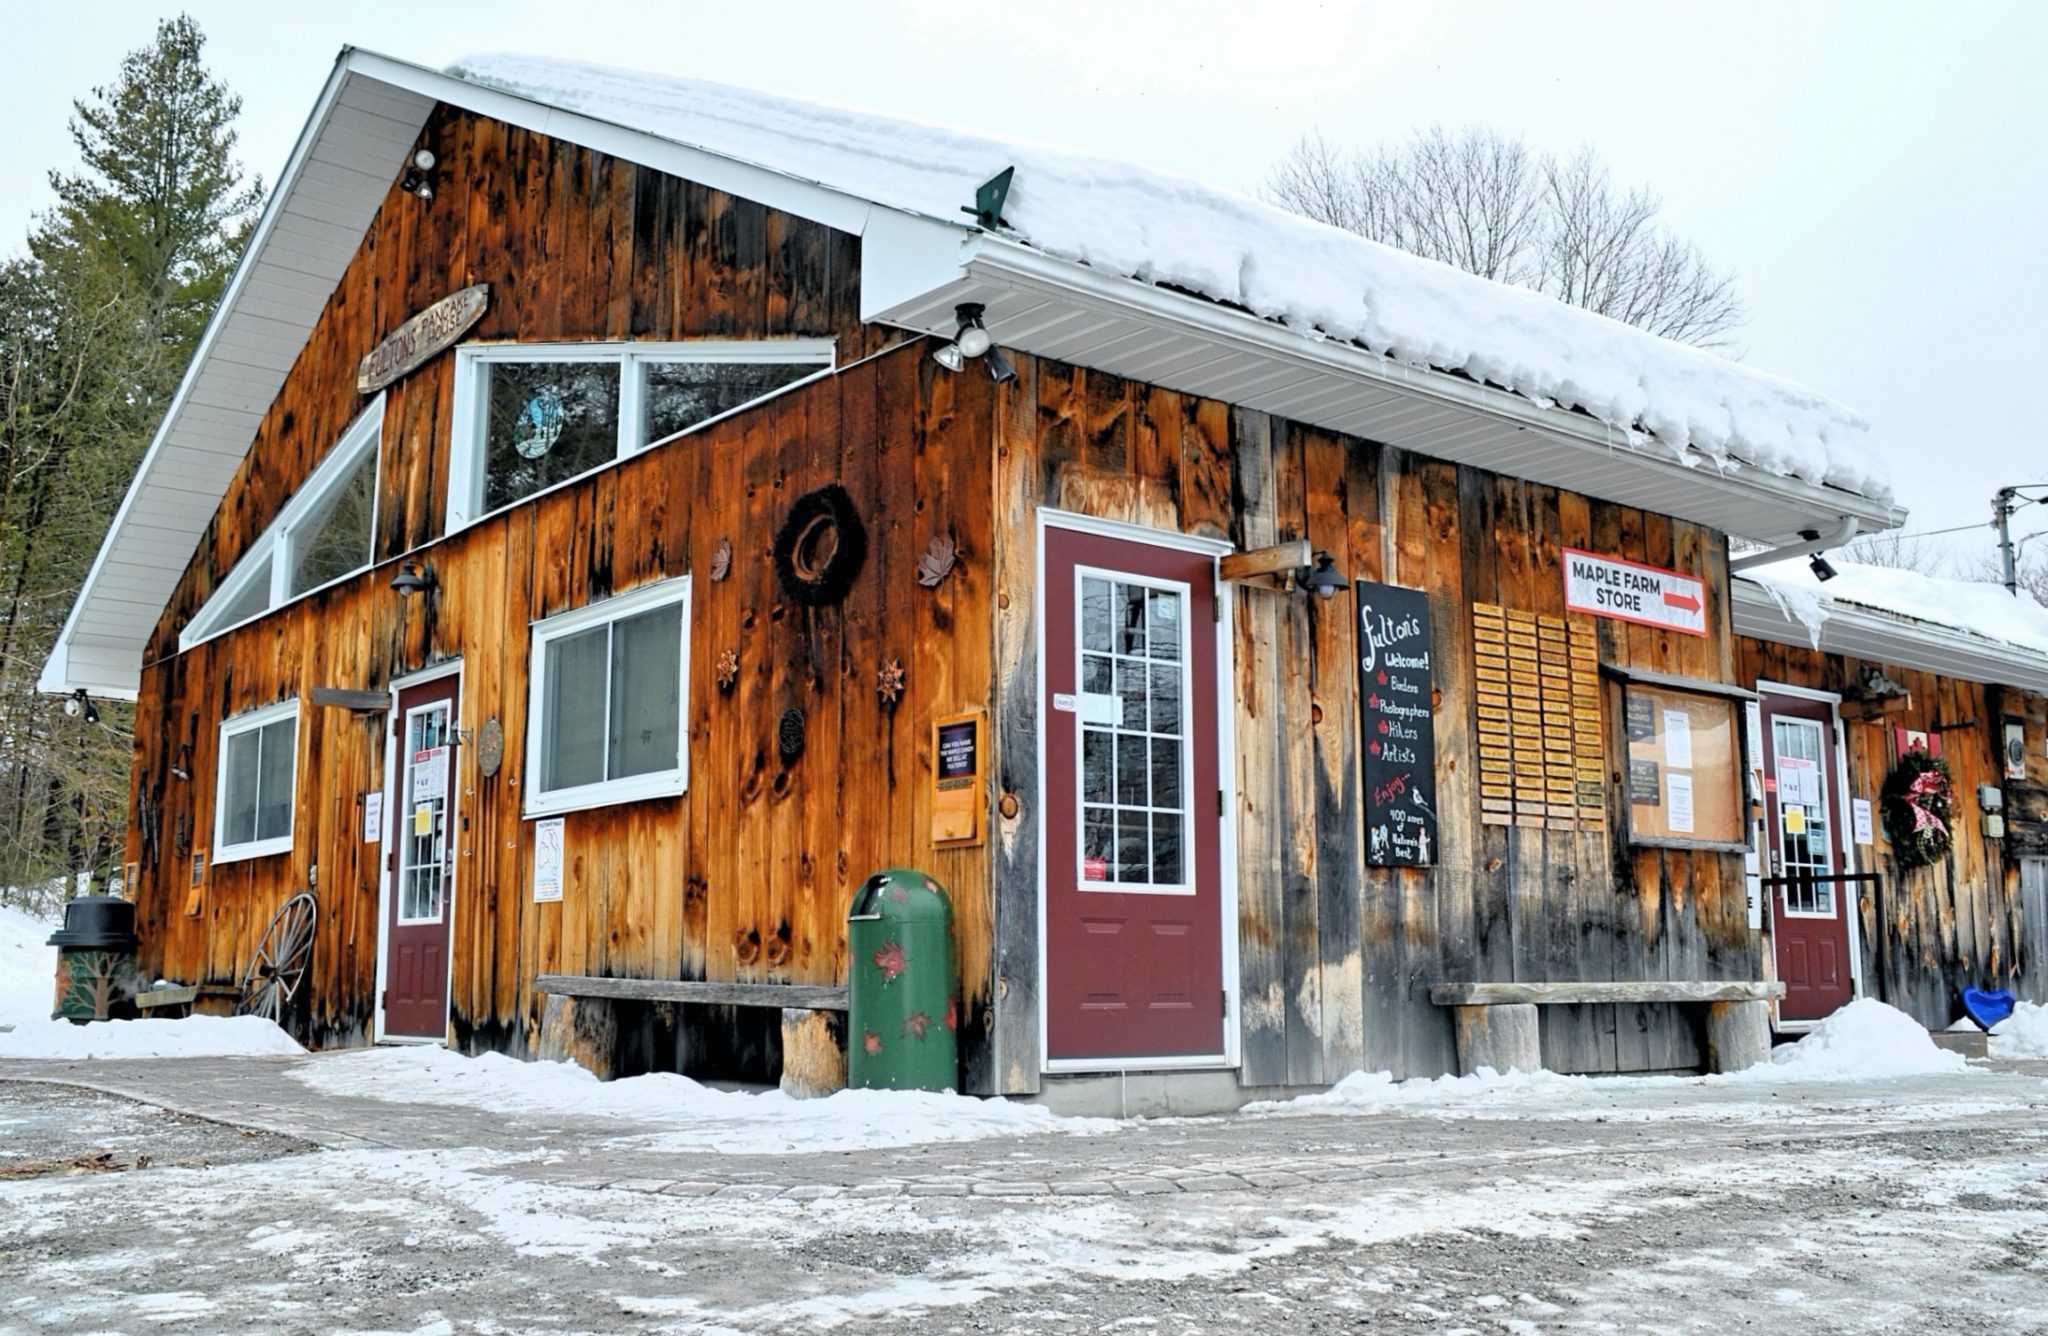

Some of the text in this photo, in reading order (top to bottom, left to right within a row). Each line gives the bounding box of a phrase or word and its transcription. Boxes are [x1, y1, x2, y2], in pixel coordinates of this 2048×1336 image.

[421, 291, 469, 336] PANCAKE
[428, 312, 461, 343] HOUSE
[1572, 561, 1661, 596] MAPLE FARM
[1596, 588, 1642, 612] STORE
[1379, 699, 1429, 721] Photographers
[1388, 720, 1418, 740] Hikers
[1382, 742, 1416, 763] Artists
